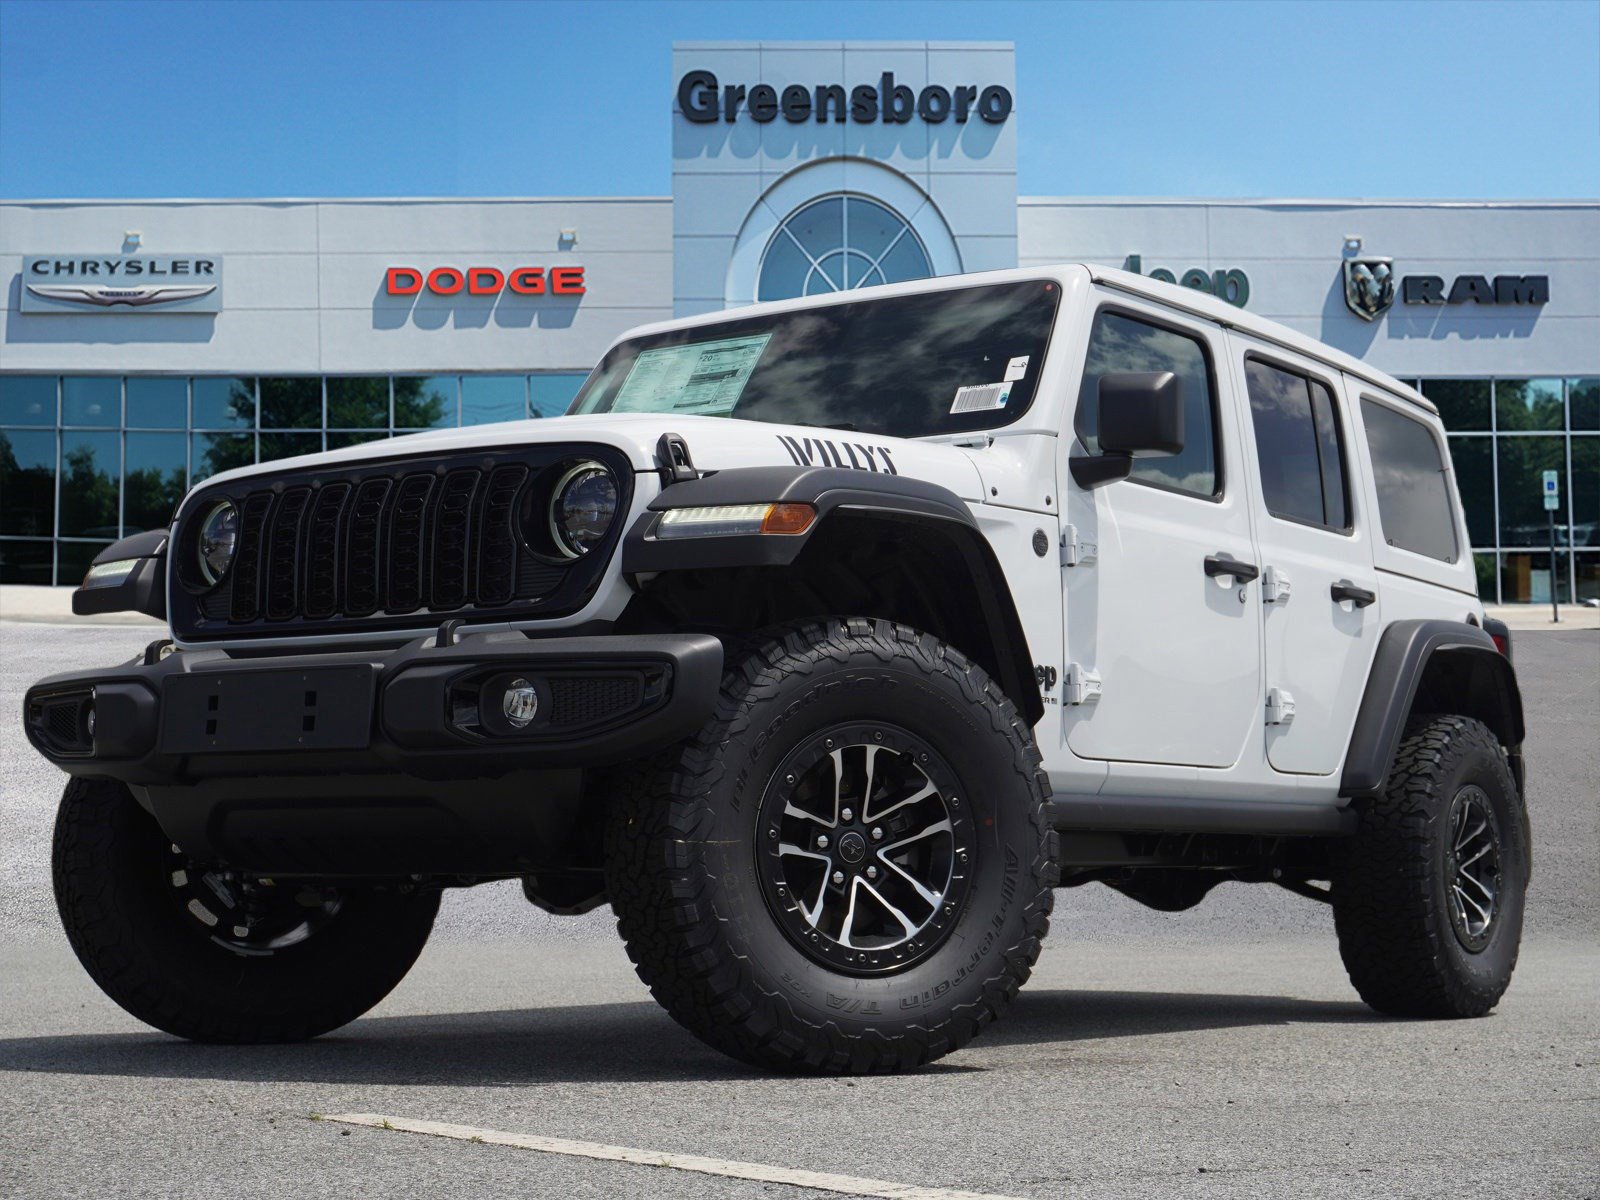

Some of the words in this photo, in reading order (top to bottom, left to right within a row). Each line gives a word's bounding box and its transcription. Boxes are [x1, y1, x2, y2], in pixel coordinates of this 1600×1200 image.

[677, 69, 1013, 125] Greensboro
[31, 259, 215, 277] CHRYSLER
[387, 266, 586, 295] DODGE
[1402, 274, 1550, 305] RAM
[776, 435, 898, 476] WILLYS
